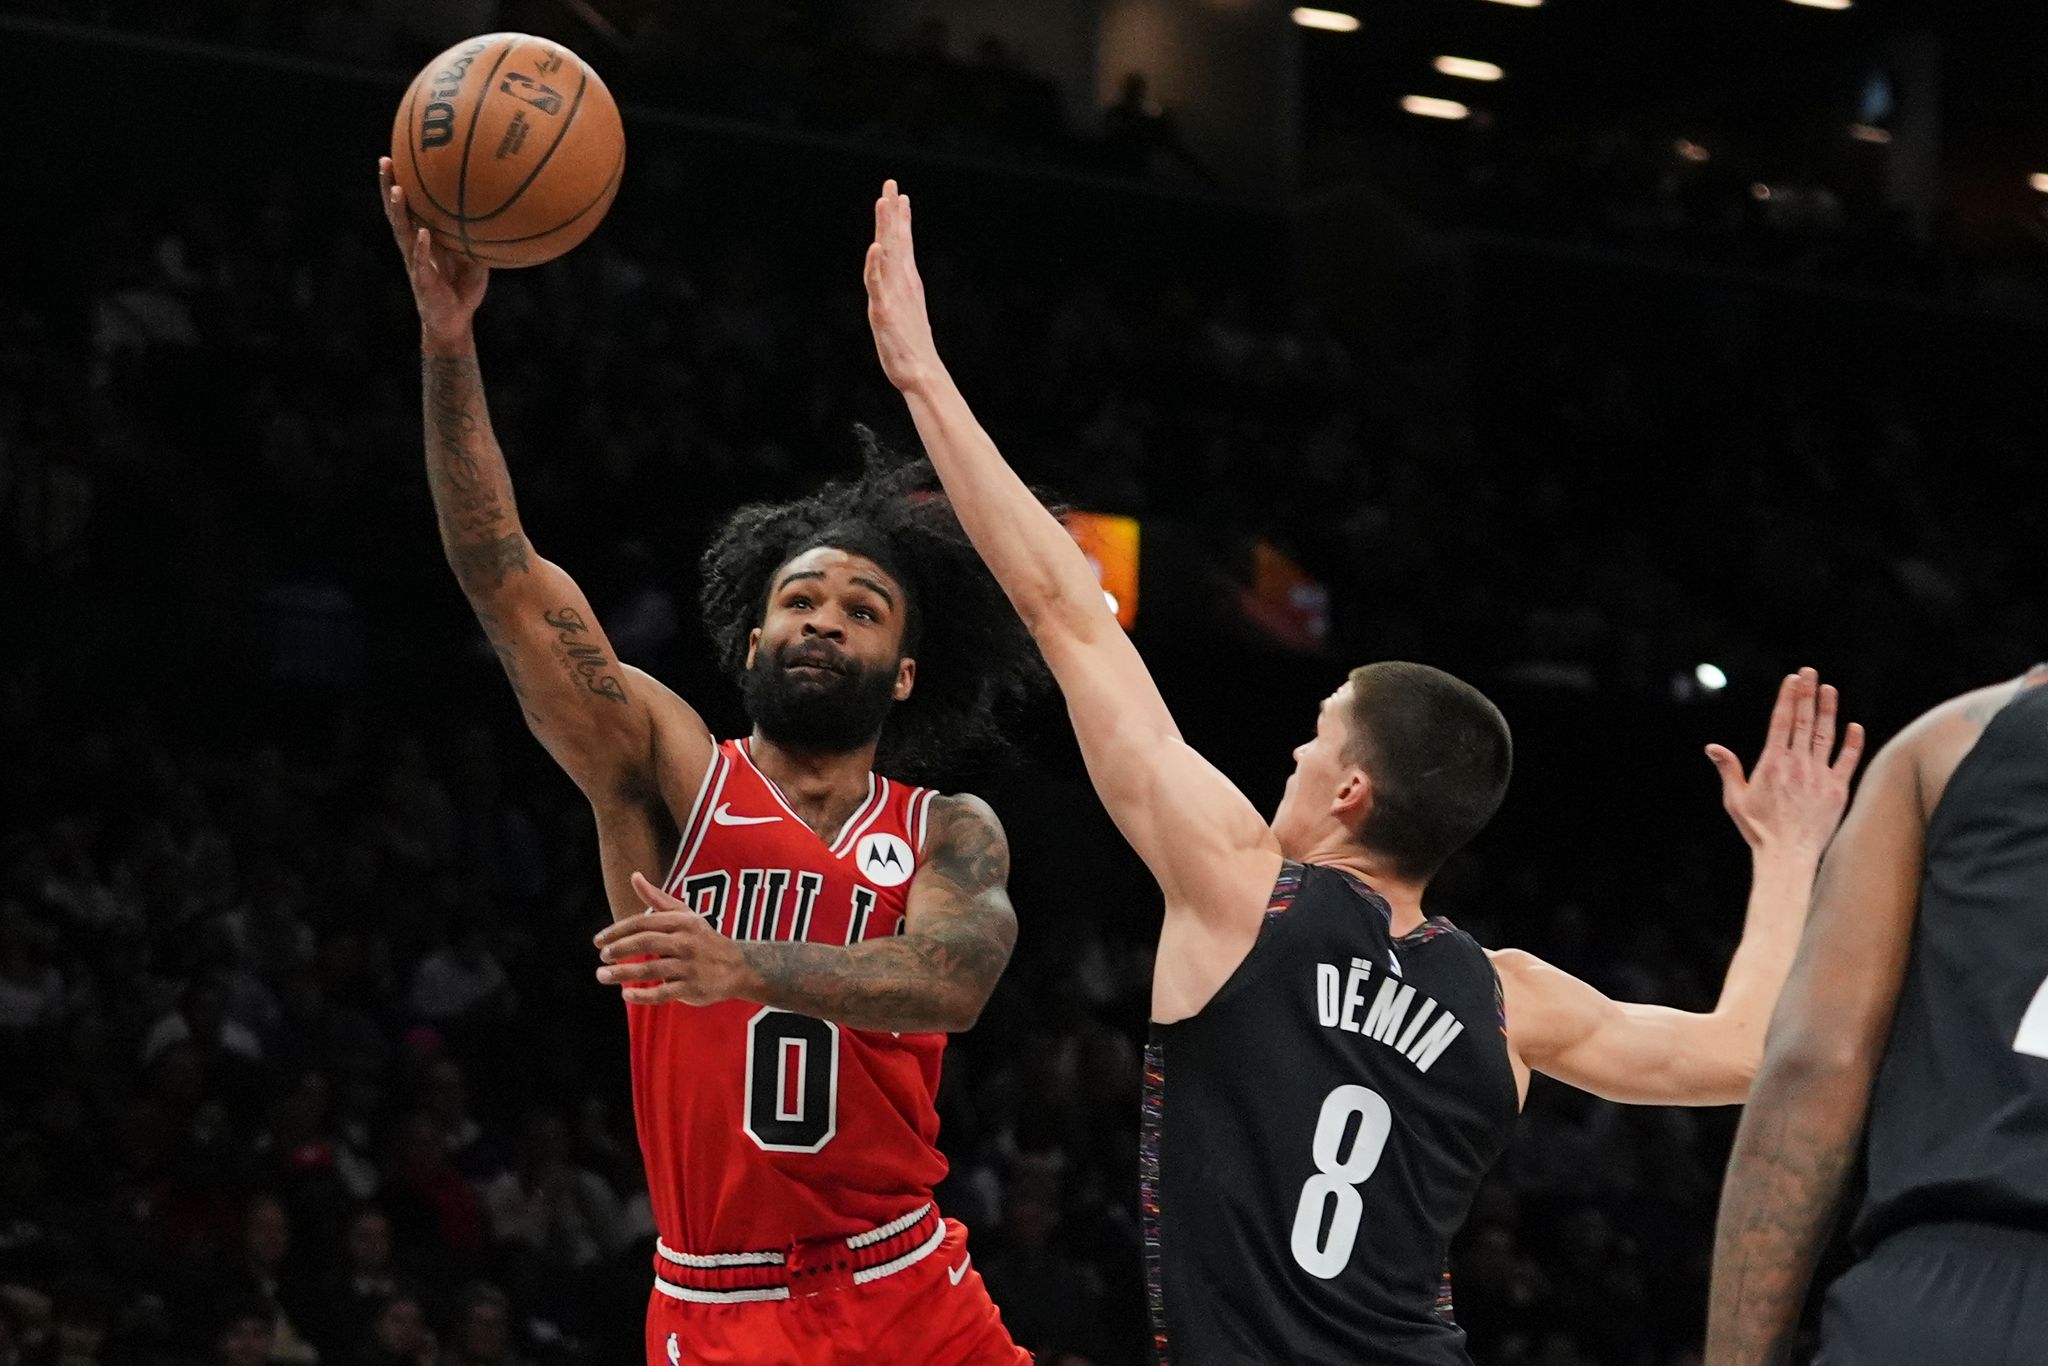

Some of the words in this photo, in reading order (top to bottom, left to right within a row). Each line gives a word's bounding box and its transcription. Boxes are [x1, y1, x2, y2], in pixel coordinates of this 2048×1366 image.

[682, 868, 905, 947] BULL
[743, 1006, 839, 1153] 0
[1316, 957, 1465, 1074] DËMIN
[1290, 1084, 1392, 1280] 8
